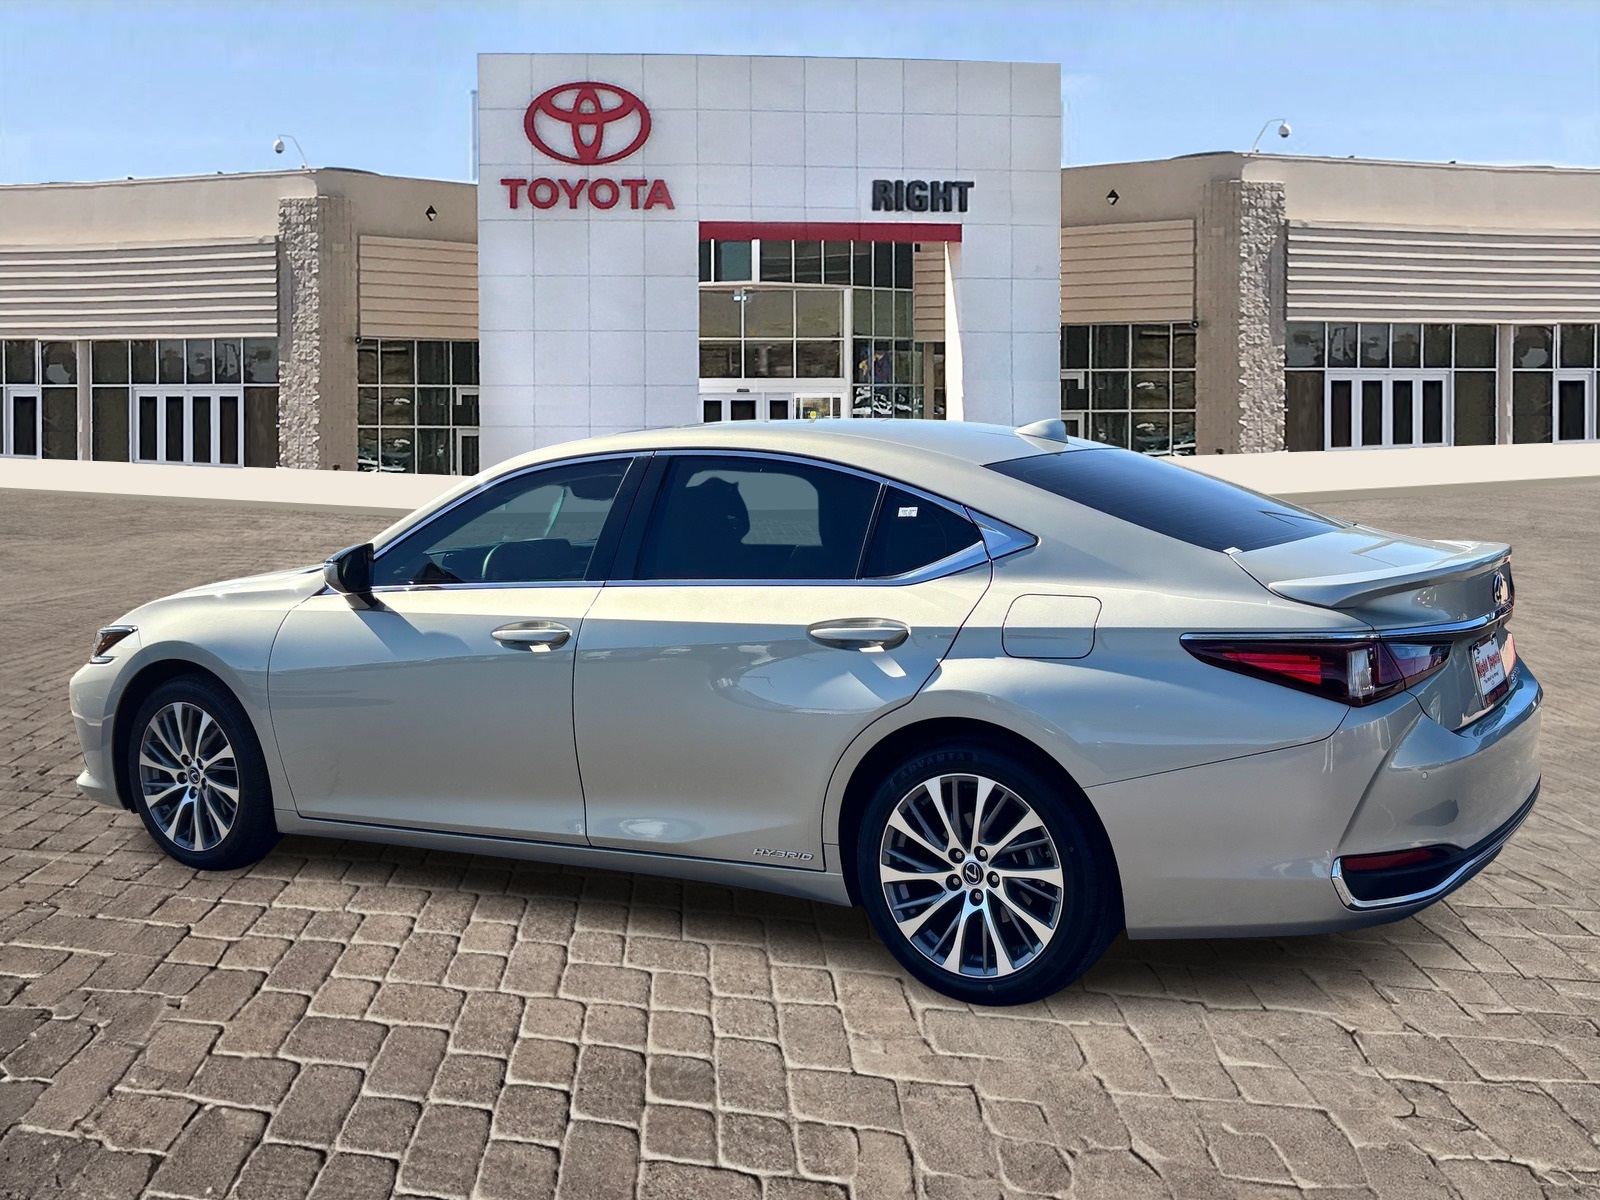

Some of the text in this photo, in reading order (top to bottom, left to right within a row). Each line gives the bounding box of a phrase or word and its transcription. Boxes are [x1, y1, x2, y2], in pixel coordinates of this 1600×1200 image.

[500, 177, 675, 209] TOYOTA
[872, 180, 975, 212] RIGHT
[900, 752, 965, 779] ADVANTA
[752, 848, 814, 861] HYBRID
